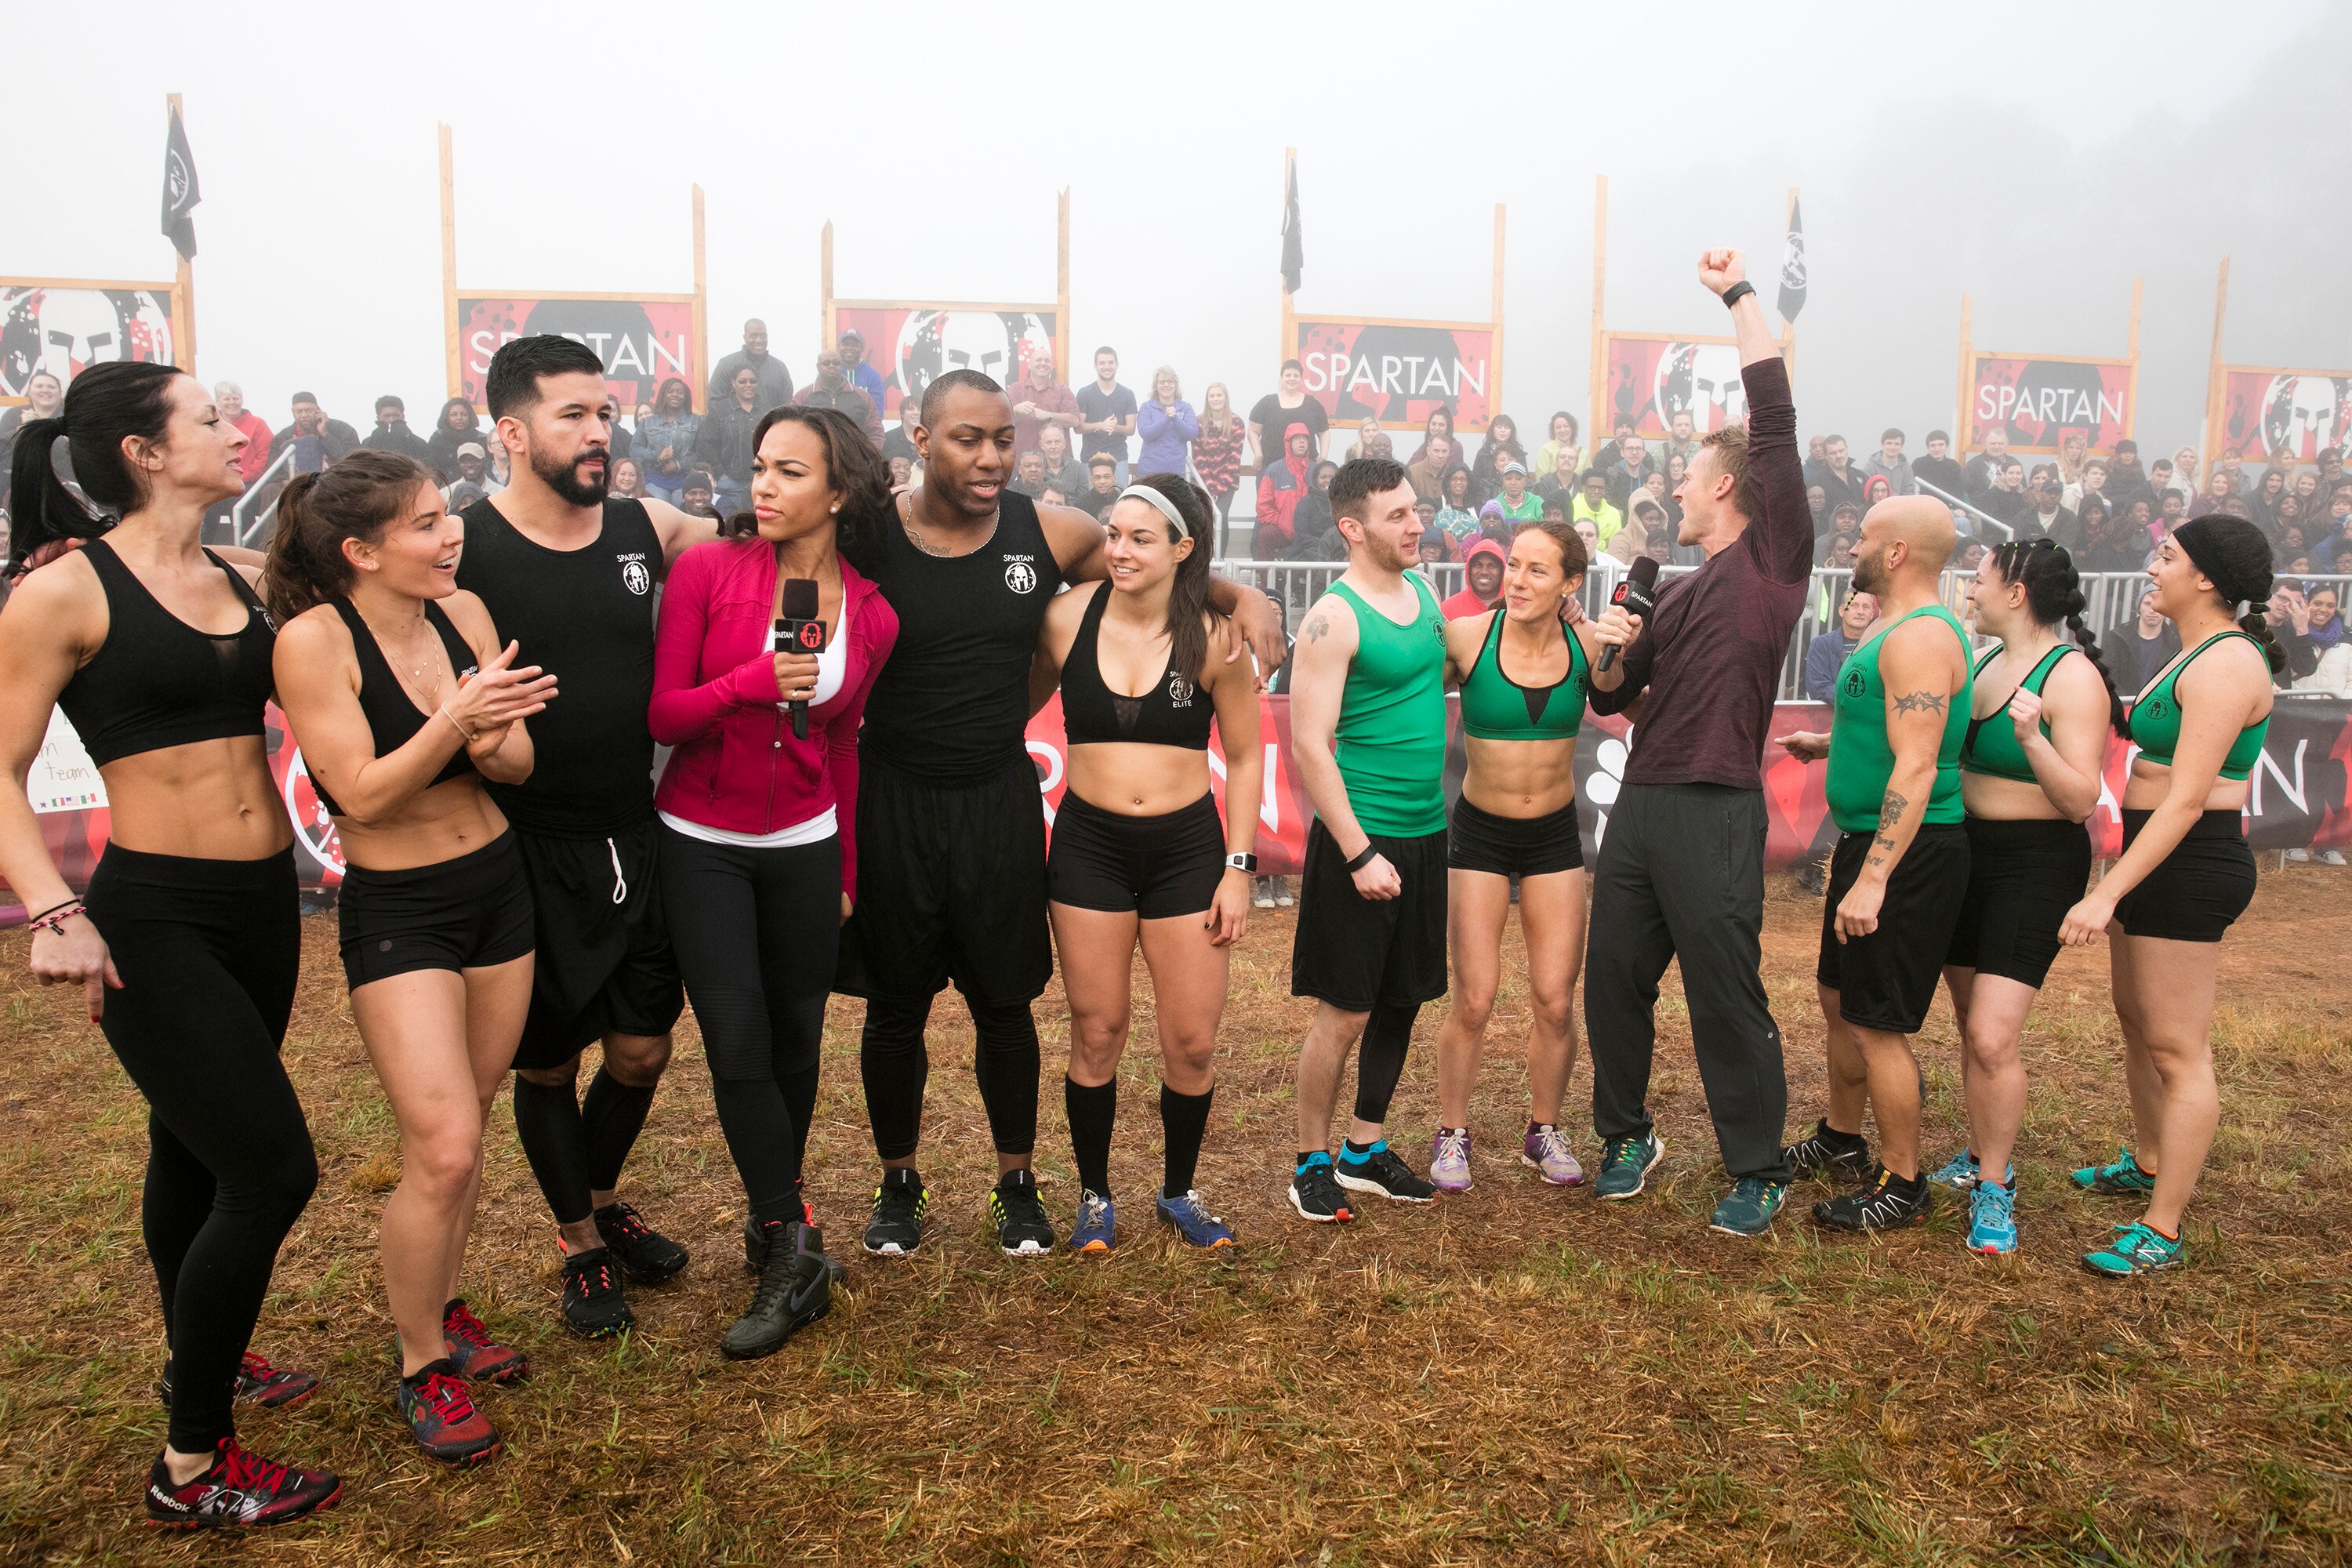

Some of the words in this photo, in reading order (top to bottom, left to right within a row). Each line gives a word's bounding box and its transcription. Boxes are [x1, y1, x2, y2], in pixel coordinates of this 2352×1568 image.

[470, 330, 686, 376] STAN
[1304, 351, 1486, 398] SPARTAN
[1977, 384, 2124, 425] SPARTAN
[616, 552, 646, 563] SPARTAN
[1003, 554, 1035, 562] SPARTAN
[1631, 590, 1653, 608] SPARTAN
[1172, 699, 1192, 708] ELITE
[44, 761, 90, 781] team
[150, 1484, 191, 1513] Reebok
